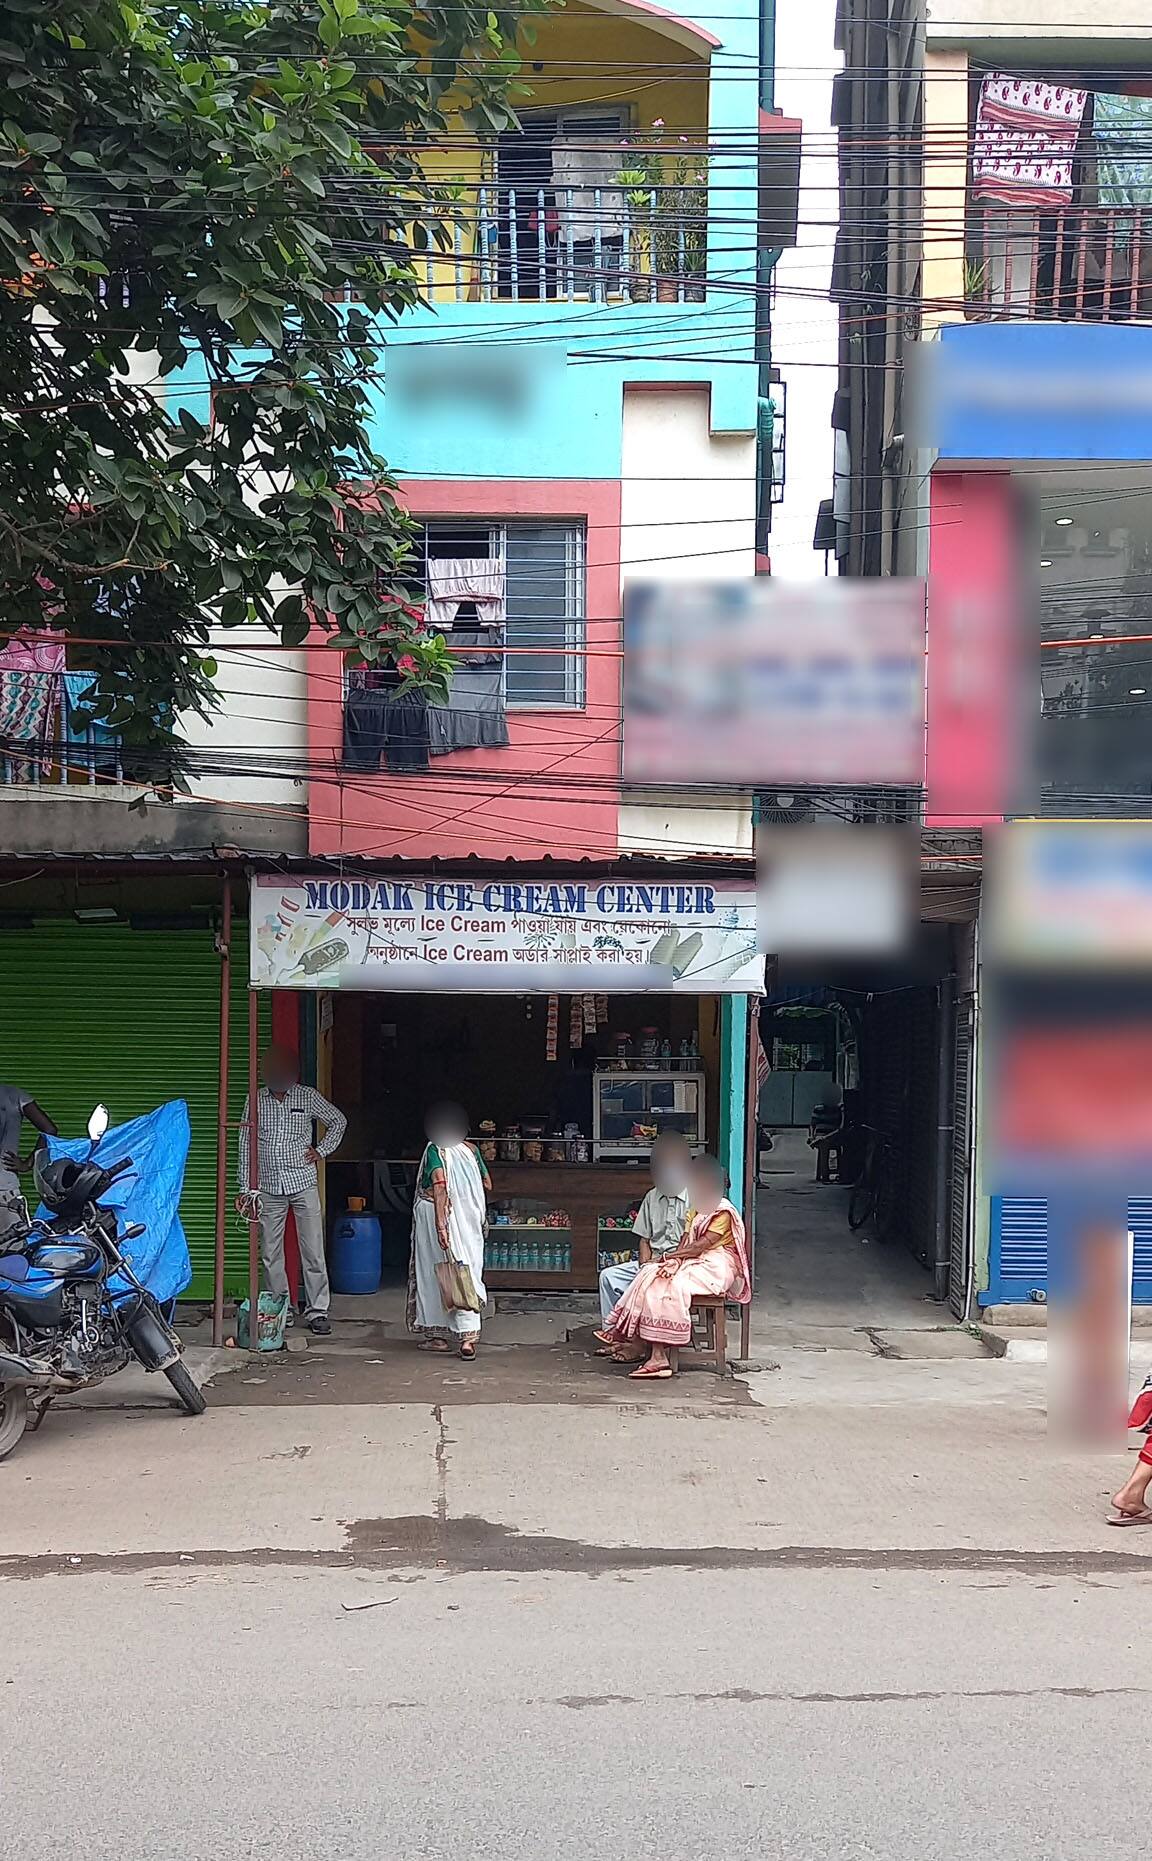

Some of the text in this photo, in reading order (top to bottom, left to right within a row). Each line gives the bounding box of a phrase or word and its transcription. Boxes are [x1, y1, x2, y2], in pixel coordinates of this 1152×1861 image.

[305, 881, 716, 914] MODAK ICE CREAM CENTER
[421, 915, 445, 932] Ice
[451, 916, 506, 933] Cream
[511, 918, 550, 934] পাওয়া
[554, 919, 577, 934] যায়
[581, 920, 608, 934] এবং
[424, 944, 447, 961] Ice
[453, 945, 508, 962] Cream
[595, 948, 620, 963] করা
